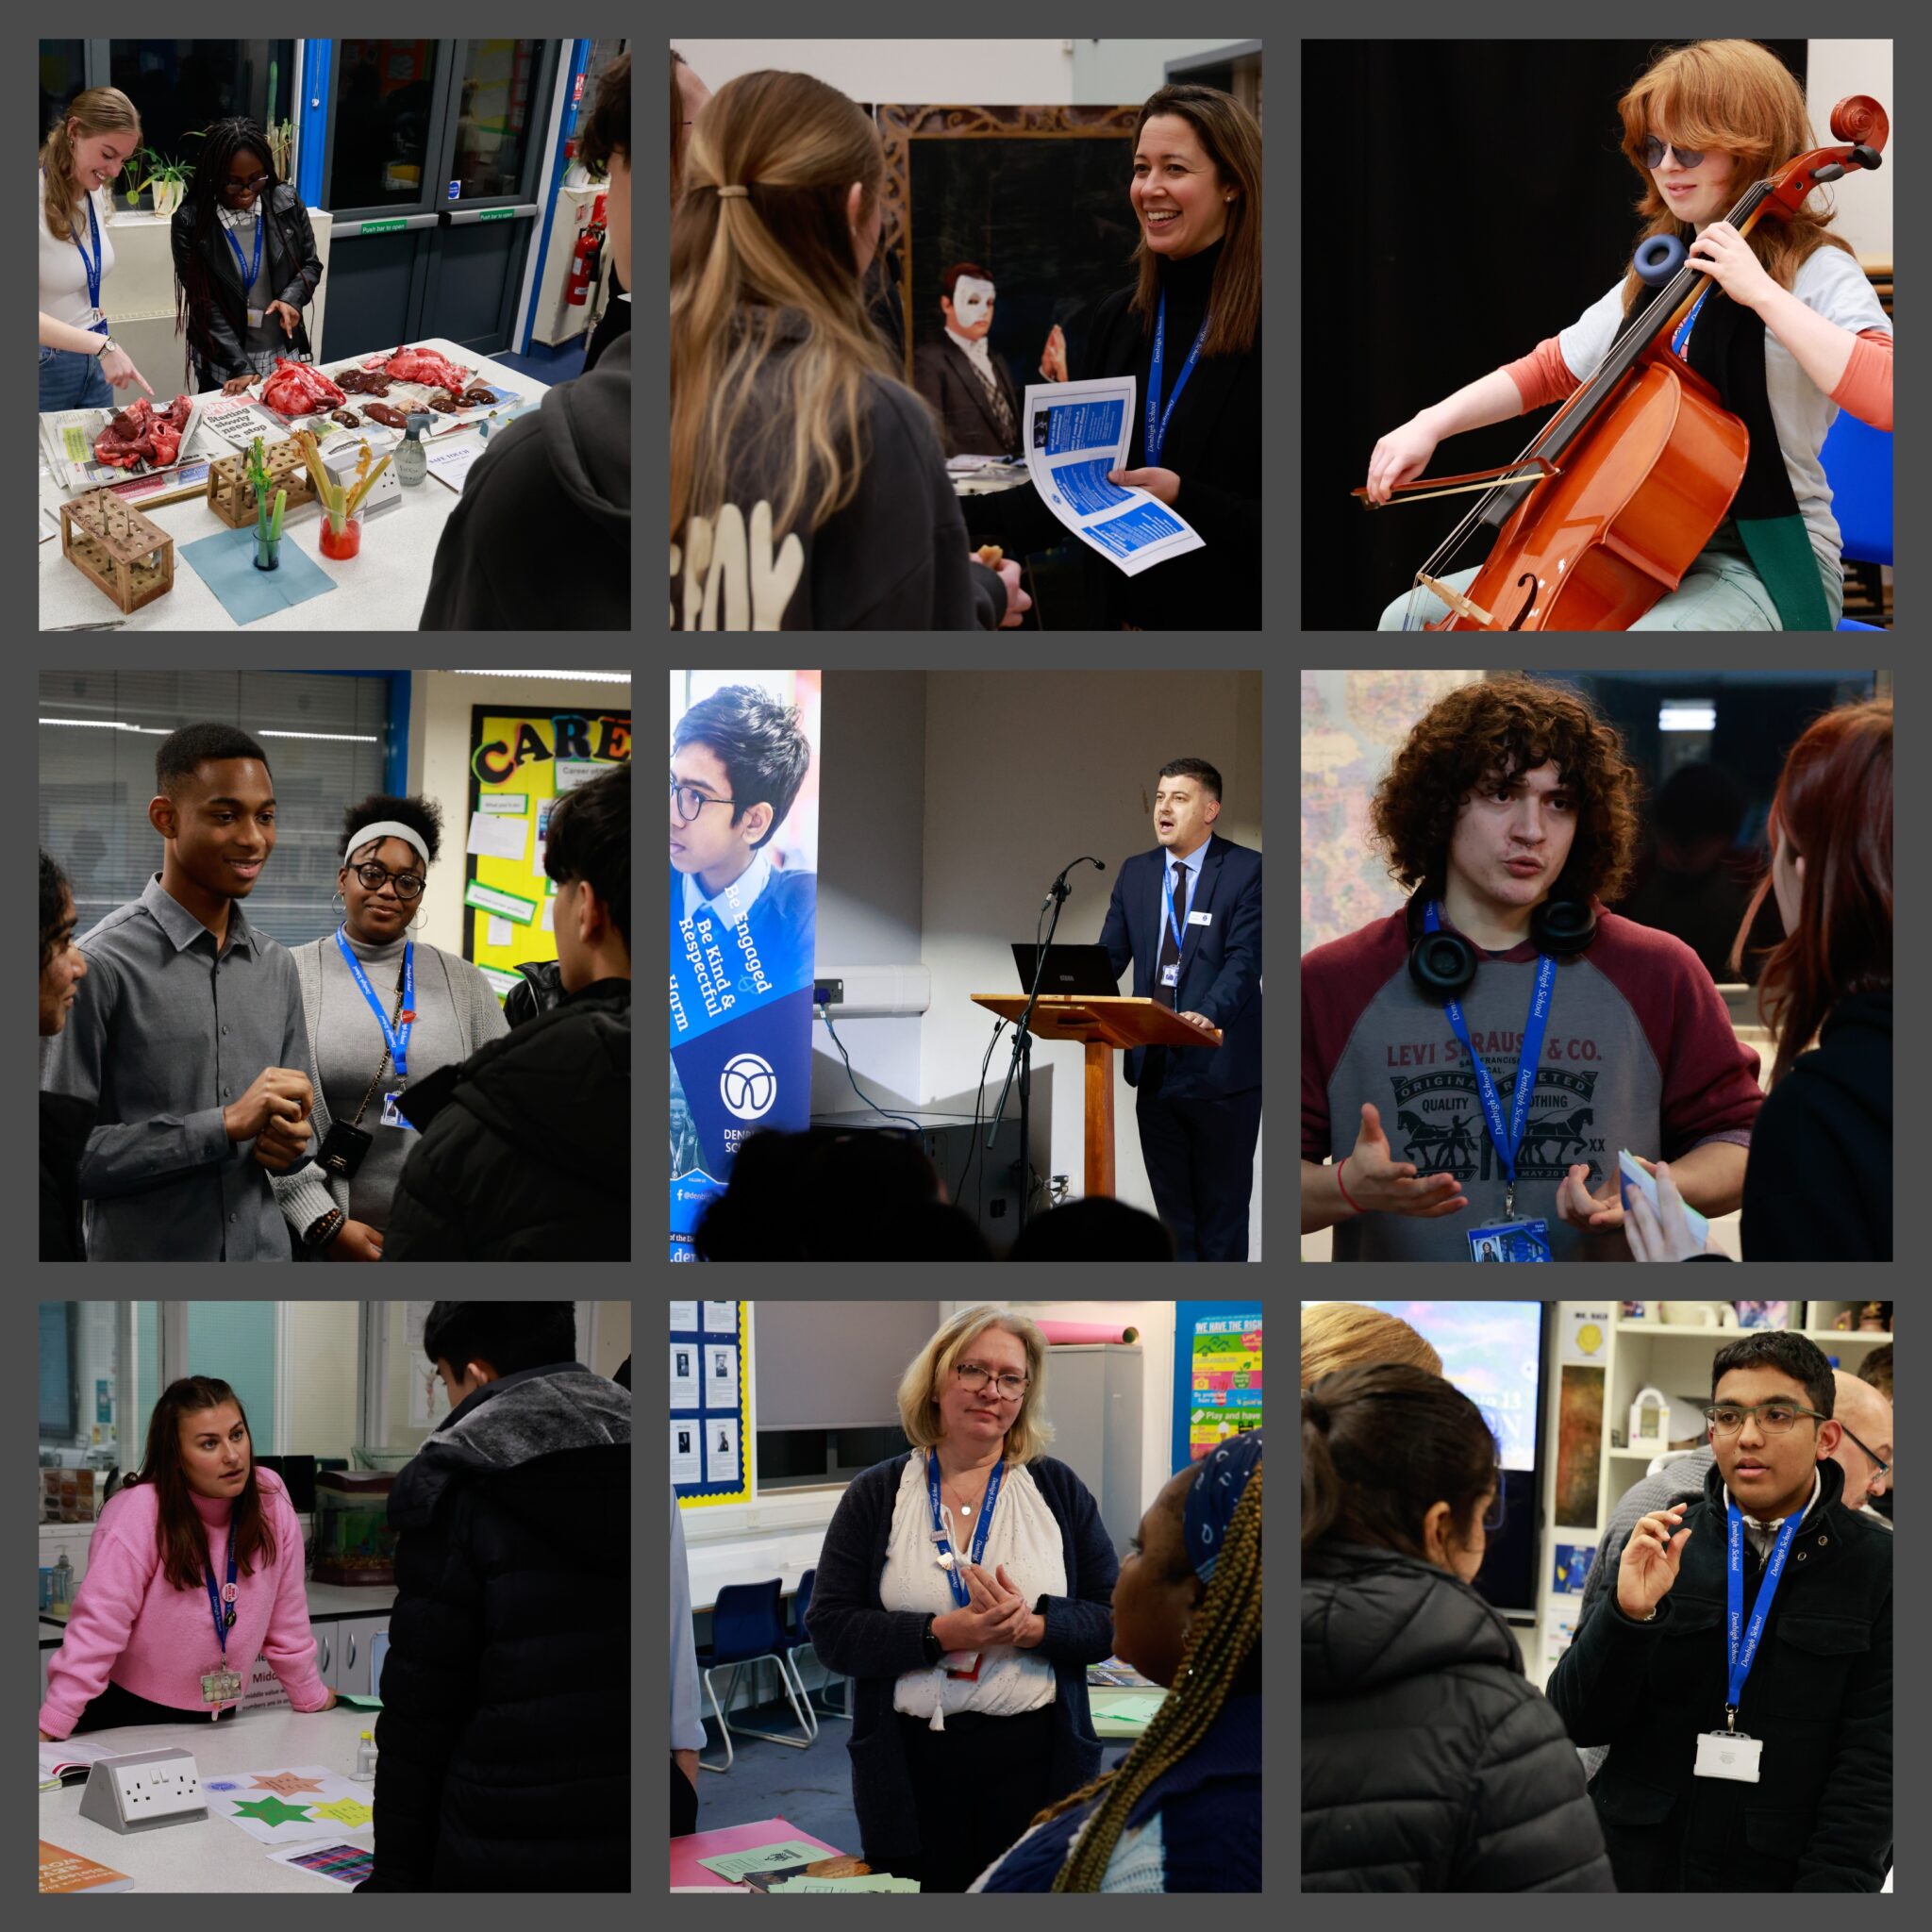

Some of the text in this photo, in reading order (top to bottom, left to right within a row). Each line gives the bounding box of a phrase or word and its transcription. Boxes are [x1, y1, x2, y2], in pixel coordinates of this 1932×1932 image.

[376, 223, 385, 232] bar
[207, 408, 251, 424] Starting
[214, 415, 251, 428] slowly
[221, 421, 256, 435] needs
[243, 424, 268, 436] stop
[1147, 401, 1157, 453] Denbigh School
[724, 884, 773, 994] Be Engaged
[678, 916, 723, 1019] Respectful
[696, 918, 736, 1010] Be Kind &
[1534, 989, 1548, 1018] School
[1388, 1042, 1436, 1067] LEVI
[1546, 1039, 1562, 1060] &
[1567, 1039, 1603, 1061] CO.
[1400, 1075, 1477, 1097] ORIGINA
[1422, 1096, 1469, 1113] QUALITY
[1480, 1070, 1504, 1136] Denbigh School
[1511, 1068, 1532, 1138] Denbigh School
[1589, 1138, 1606, 1153] XX
[1195, 1322, 1208, 1334] WE
[1208, 1321, 1227, 1333] HAVE
[1228, 1320, 1243, 1332] THE
[1207, 1411, 1260, 1422] Play and have
[1729, 1521, 1740, 1572] Denbigh School
[1770, 1525, 1793, 1577] Denbigh School
[1729, 1611, 1740, 1665] Denbigh School
[1740, 1614, 1763, 1668] Denbigh School
